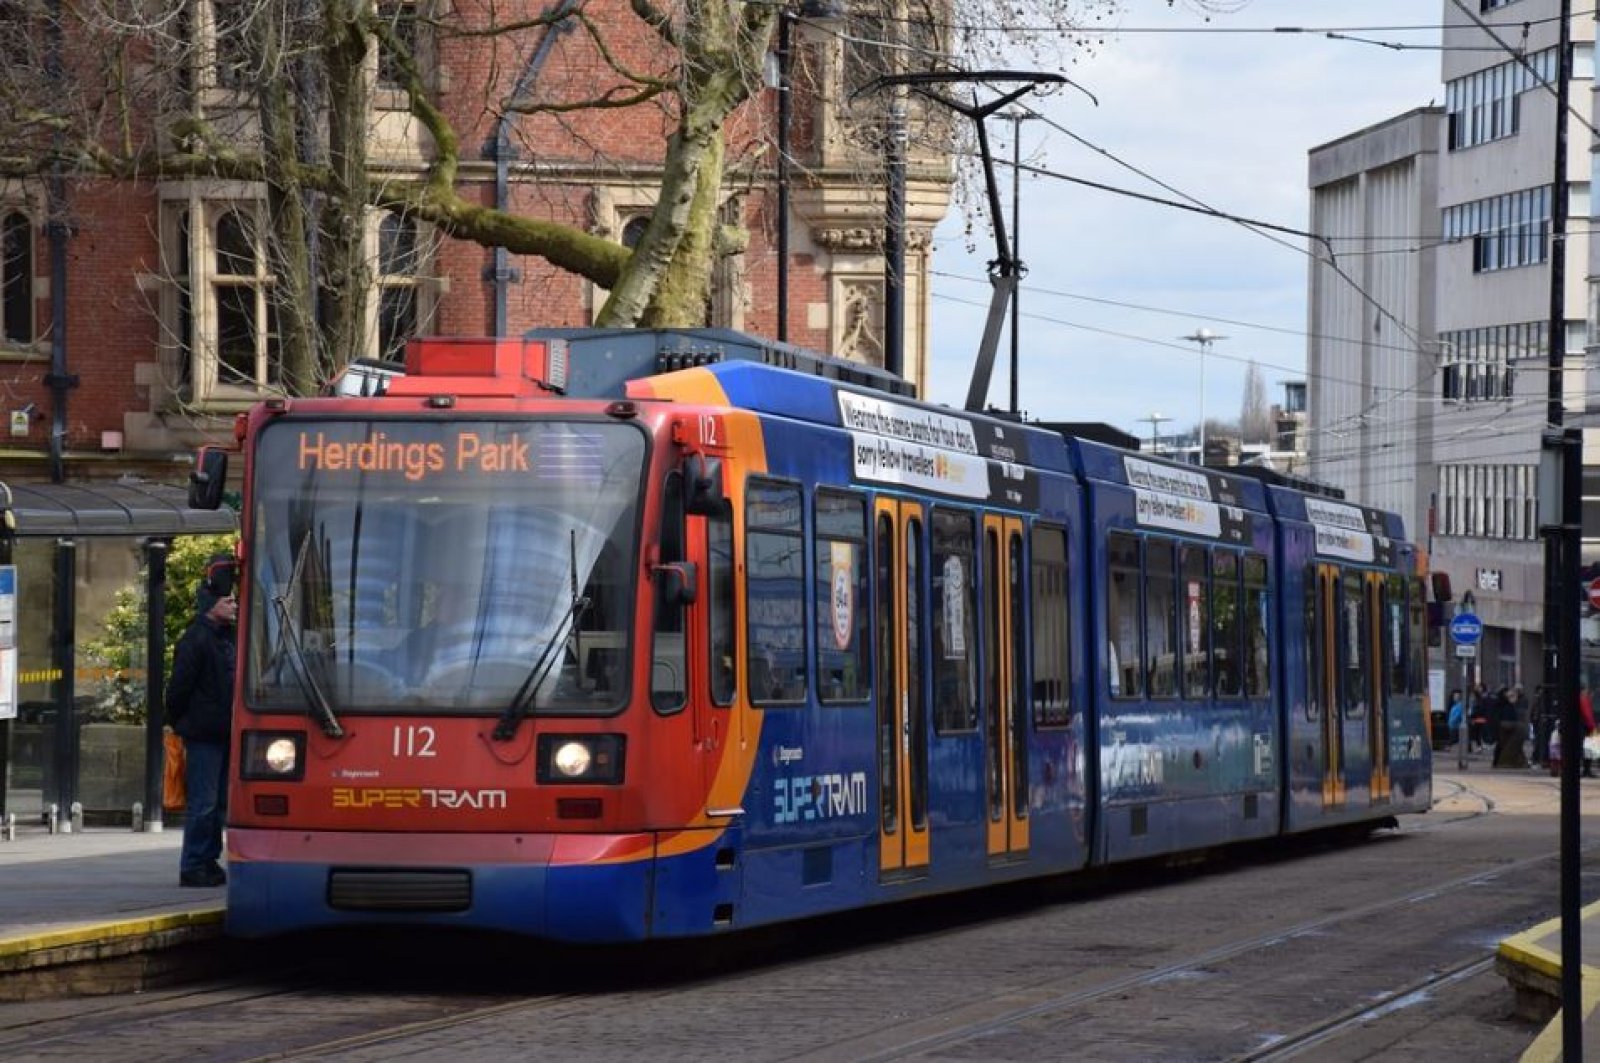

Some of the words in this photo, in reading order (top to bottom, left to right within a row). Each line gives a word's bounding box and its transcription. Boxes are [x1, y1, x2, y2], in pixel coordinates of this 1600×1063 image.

[698, 414, 716, 446] 112
[299, 432, 445, 480] Herdings
[456, 432, 529, 472] Park
[857, 445, 876, 474] sorry
[393, 725, 437, 757] 112
[332, 787, 507, 808] SUPERTRAM
[774, 772, 867, 823] SUPERTRAM
